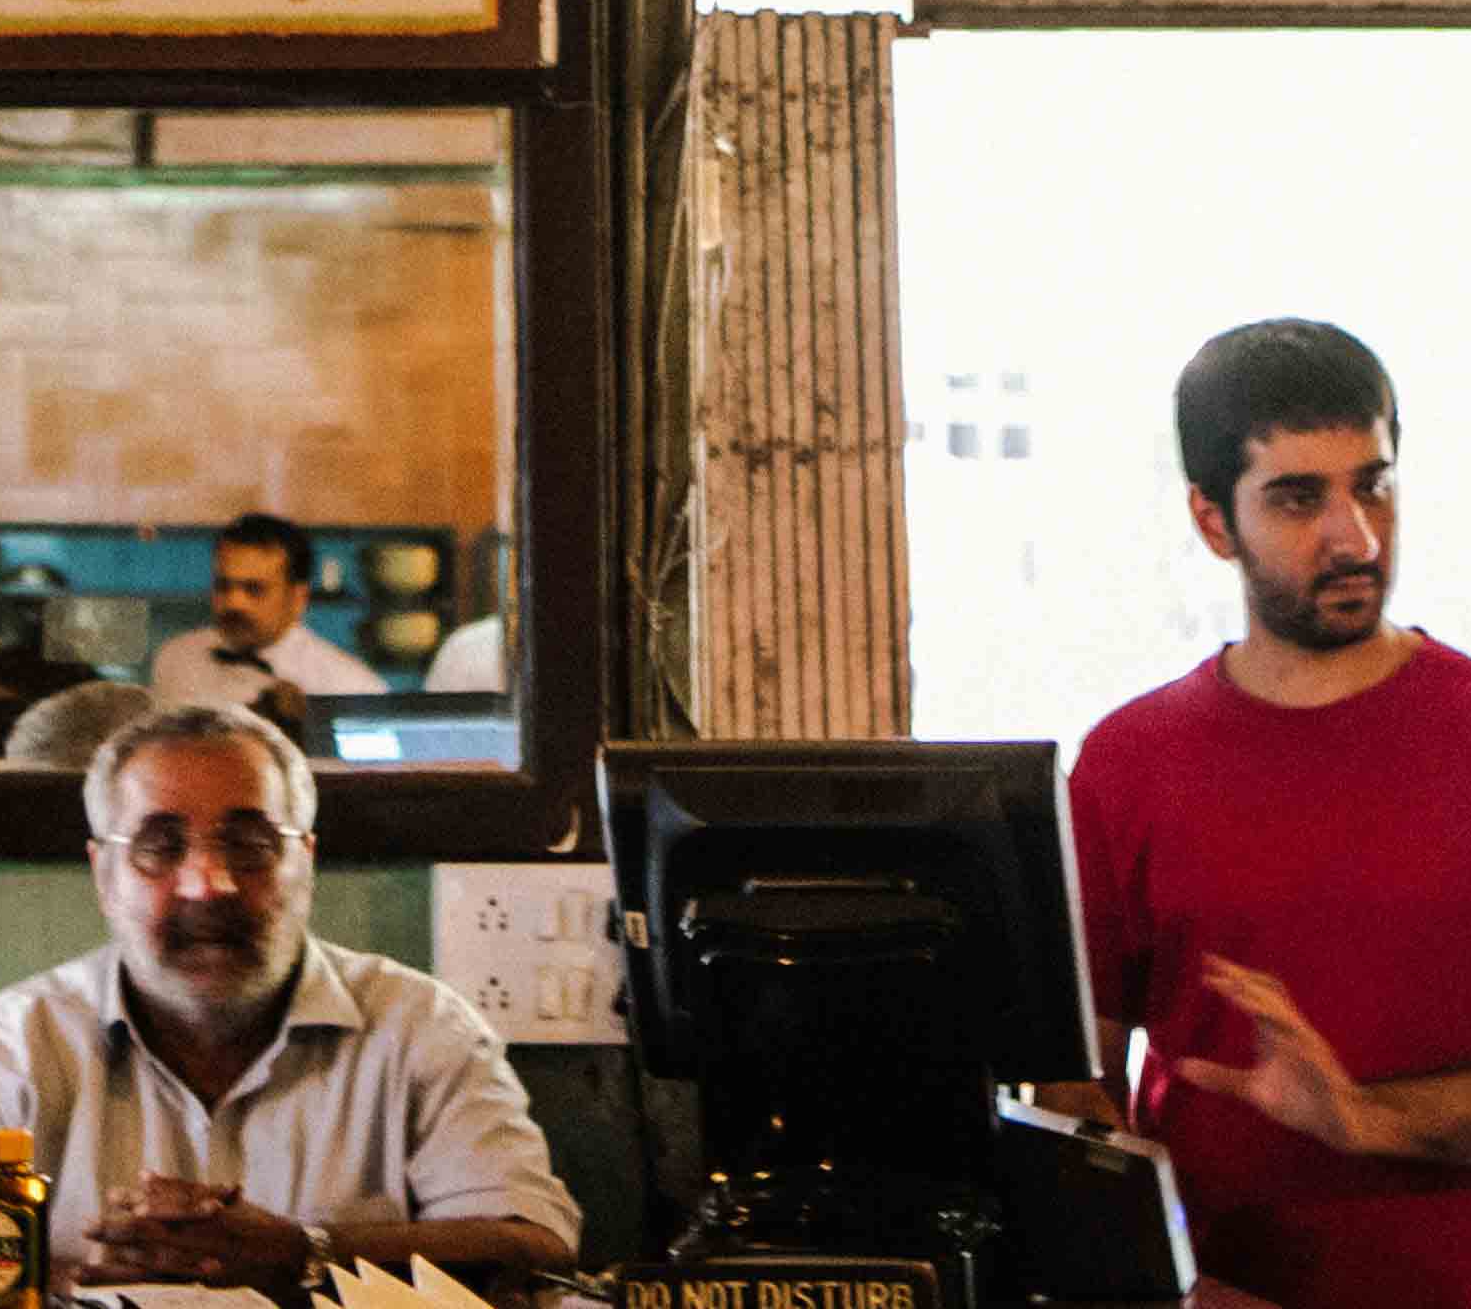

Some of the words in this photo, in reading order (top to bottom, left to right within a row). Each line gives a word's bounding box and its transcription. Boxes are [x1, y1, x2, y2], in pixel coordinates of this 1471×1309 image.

[625, 1280, 671, 1309] DO
[681, 1280, 750, 1309] NOT
[758, 1280, 916, 1309] DISTURB
